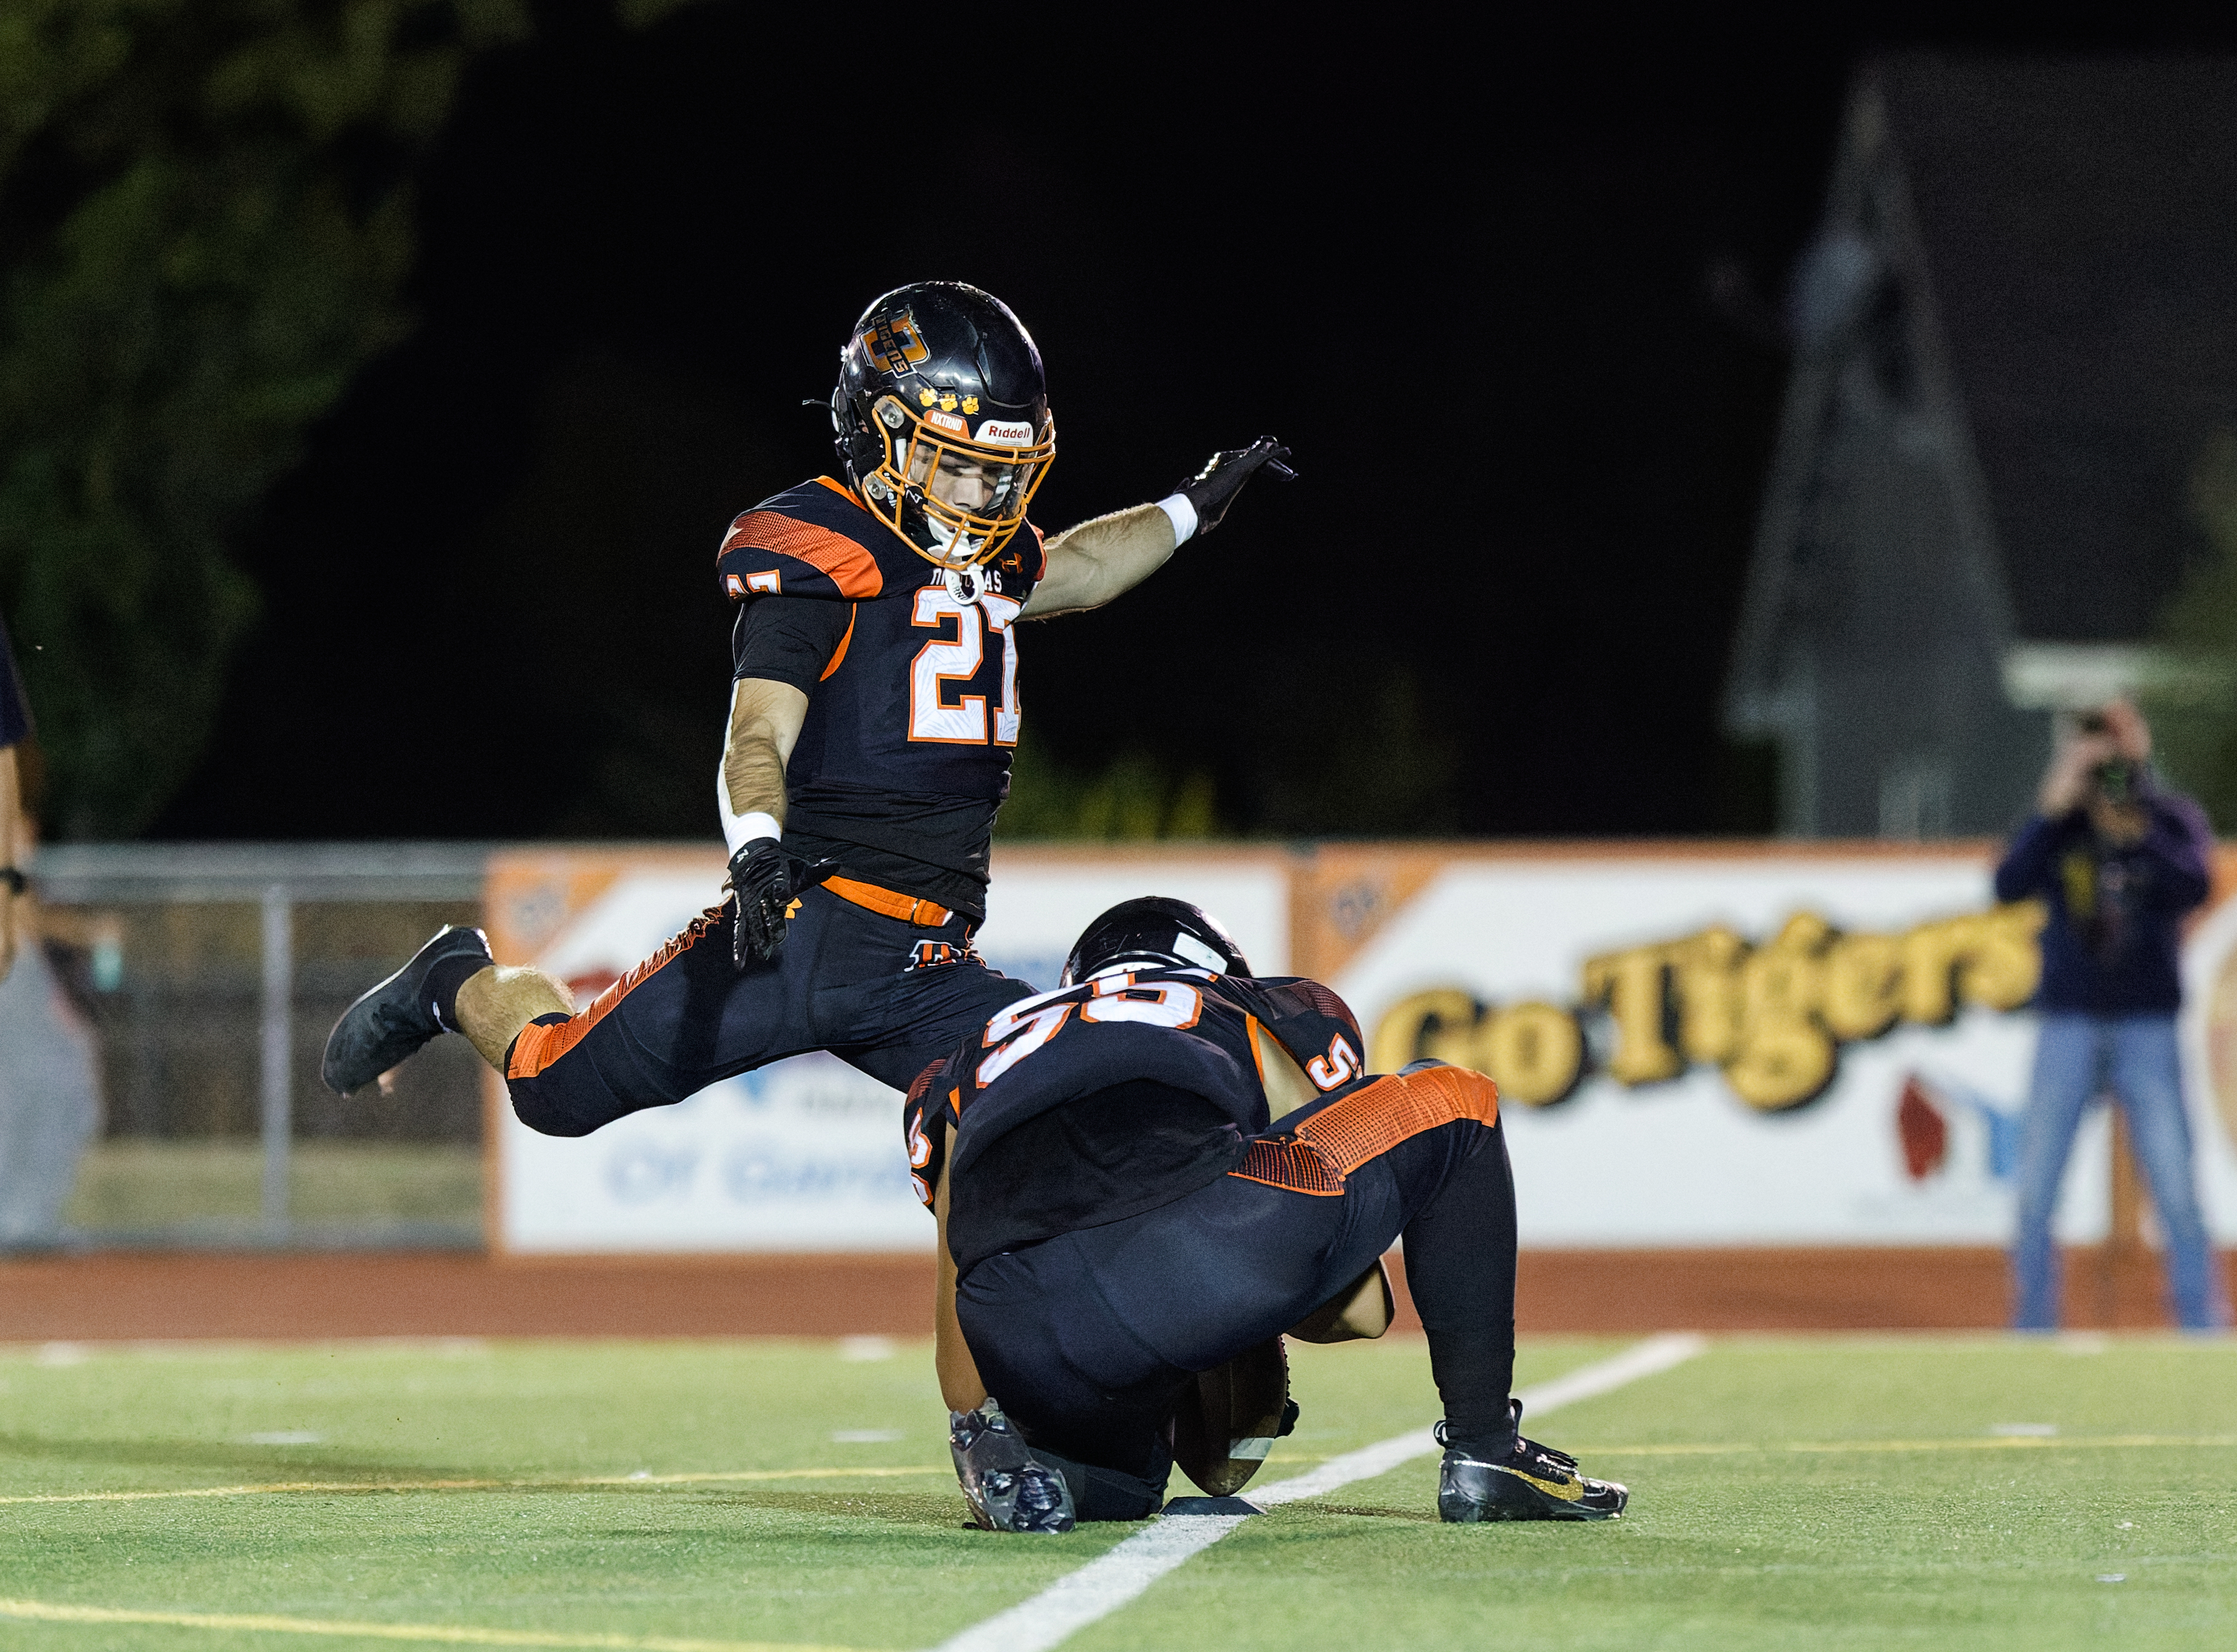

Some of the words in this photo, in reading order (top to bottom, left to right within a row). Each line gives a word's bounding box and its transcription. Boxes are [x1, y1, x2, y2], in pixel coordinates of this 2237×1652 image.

[930, 411, 963, 431] NXTRND
[988, 425, 1030, 438] Riddell
[1370, 988, 1588, 1110] Go
[1582, 898, 2048, 1110] Tigers
[1305, 1032, 1363, 1091] 5
